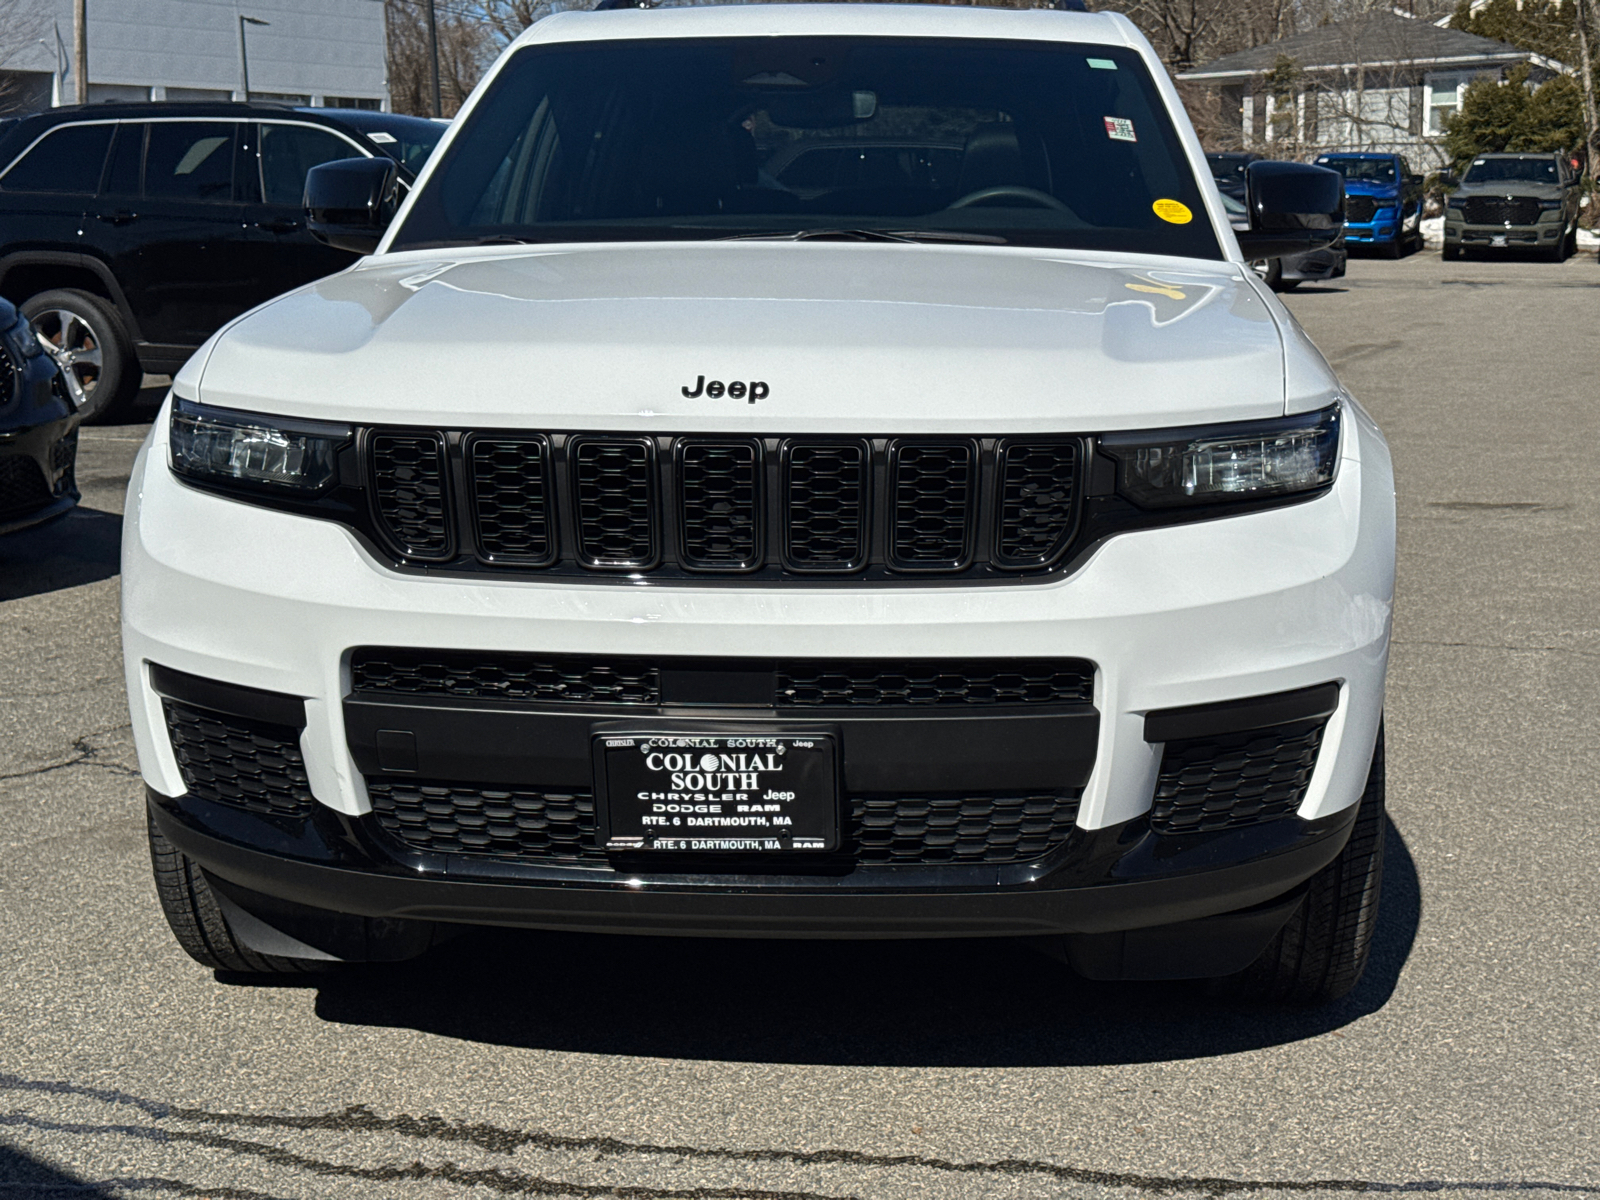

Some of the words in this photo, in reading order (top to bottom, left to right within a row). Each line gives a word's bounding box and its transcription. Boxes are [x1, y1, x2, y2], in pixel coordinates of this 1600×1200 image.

[681, 375, 770, 404] Jeep
[726, 739, 777, 748] SOUTH
[792, 740, 814, 748] Jeep
[645, 753, 783, 772] COLONIAL
[671, 772, 760, 791] SOUTH
[637, 792, 749, 801] CHRYSLER
[763, 789, 795, 802] Jeep
[652, 804, 722, 813] DODGE
[737, 804, 781, 812] RAM
[642, 816, 670, 826] RTE.
[672, 817, 681, 826] 6
[687, 817, 770, 827] DARTMOUTH,
[772, 816, 793, 826] MA
[653, 841, 678, 850] RTE.
[679, 841, 687, 849] 6
[691, 841, 762, 850] DARTMOUTH,
[764, 841, 782, 849] MA
